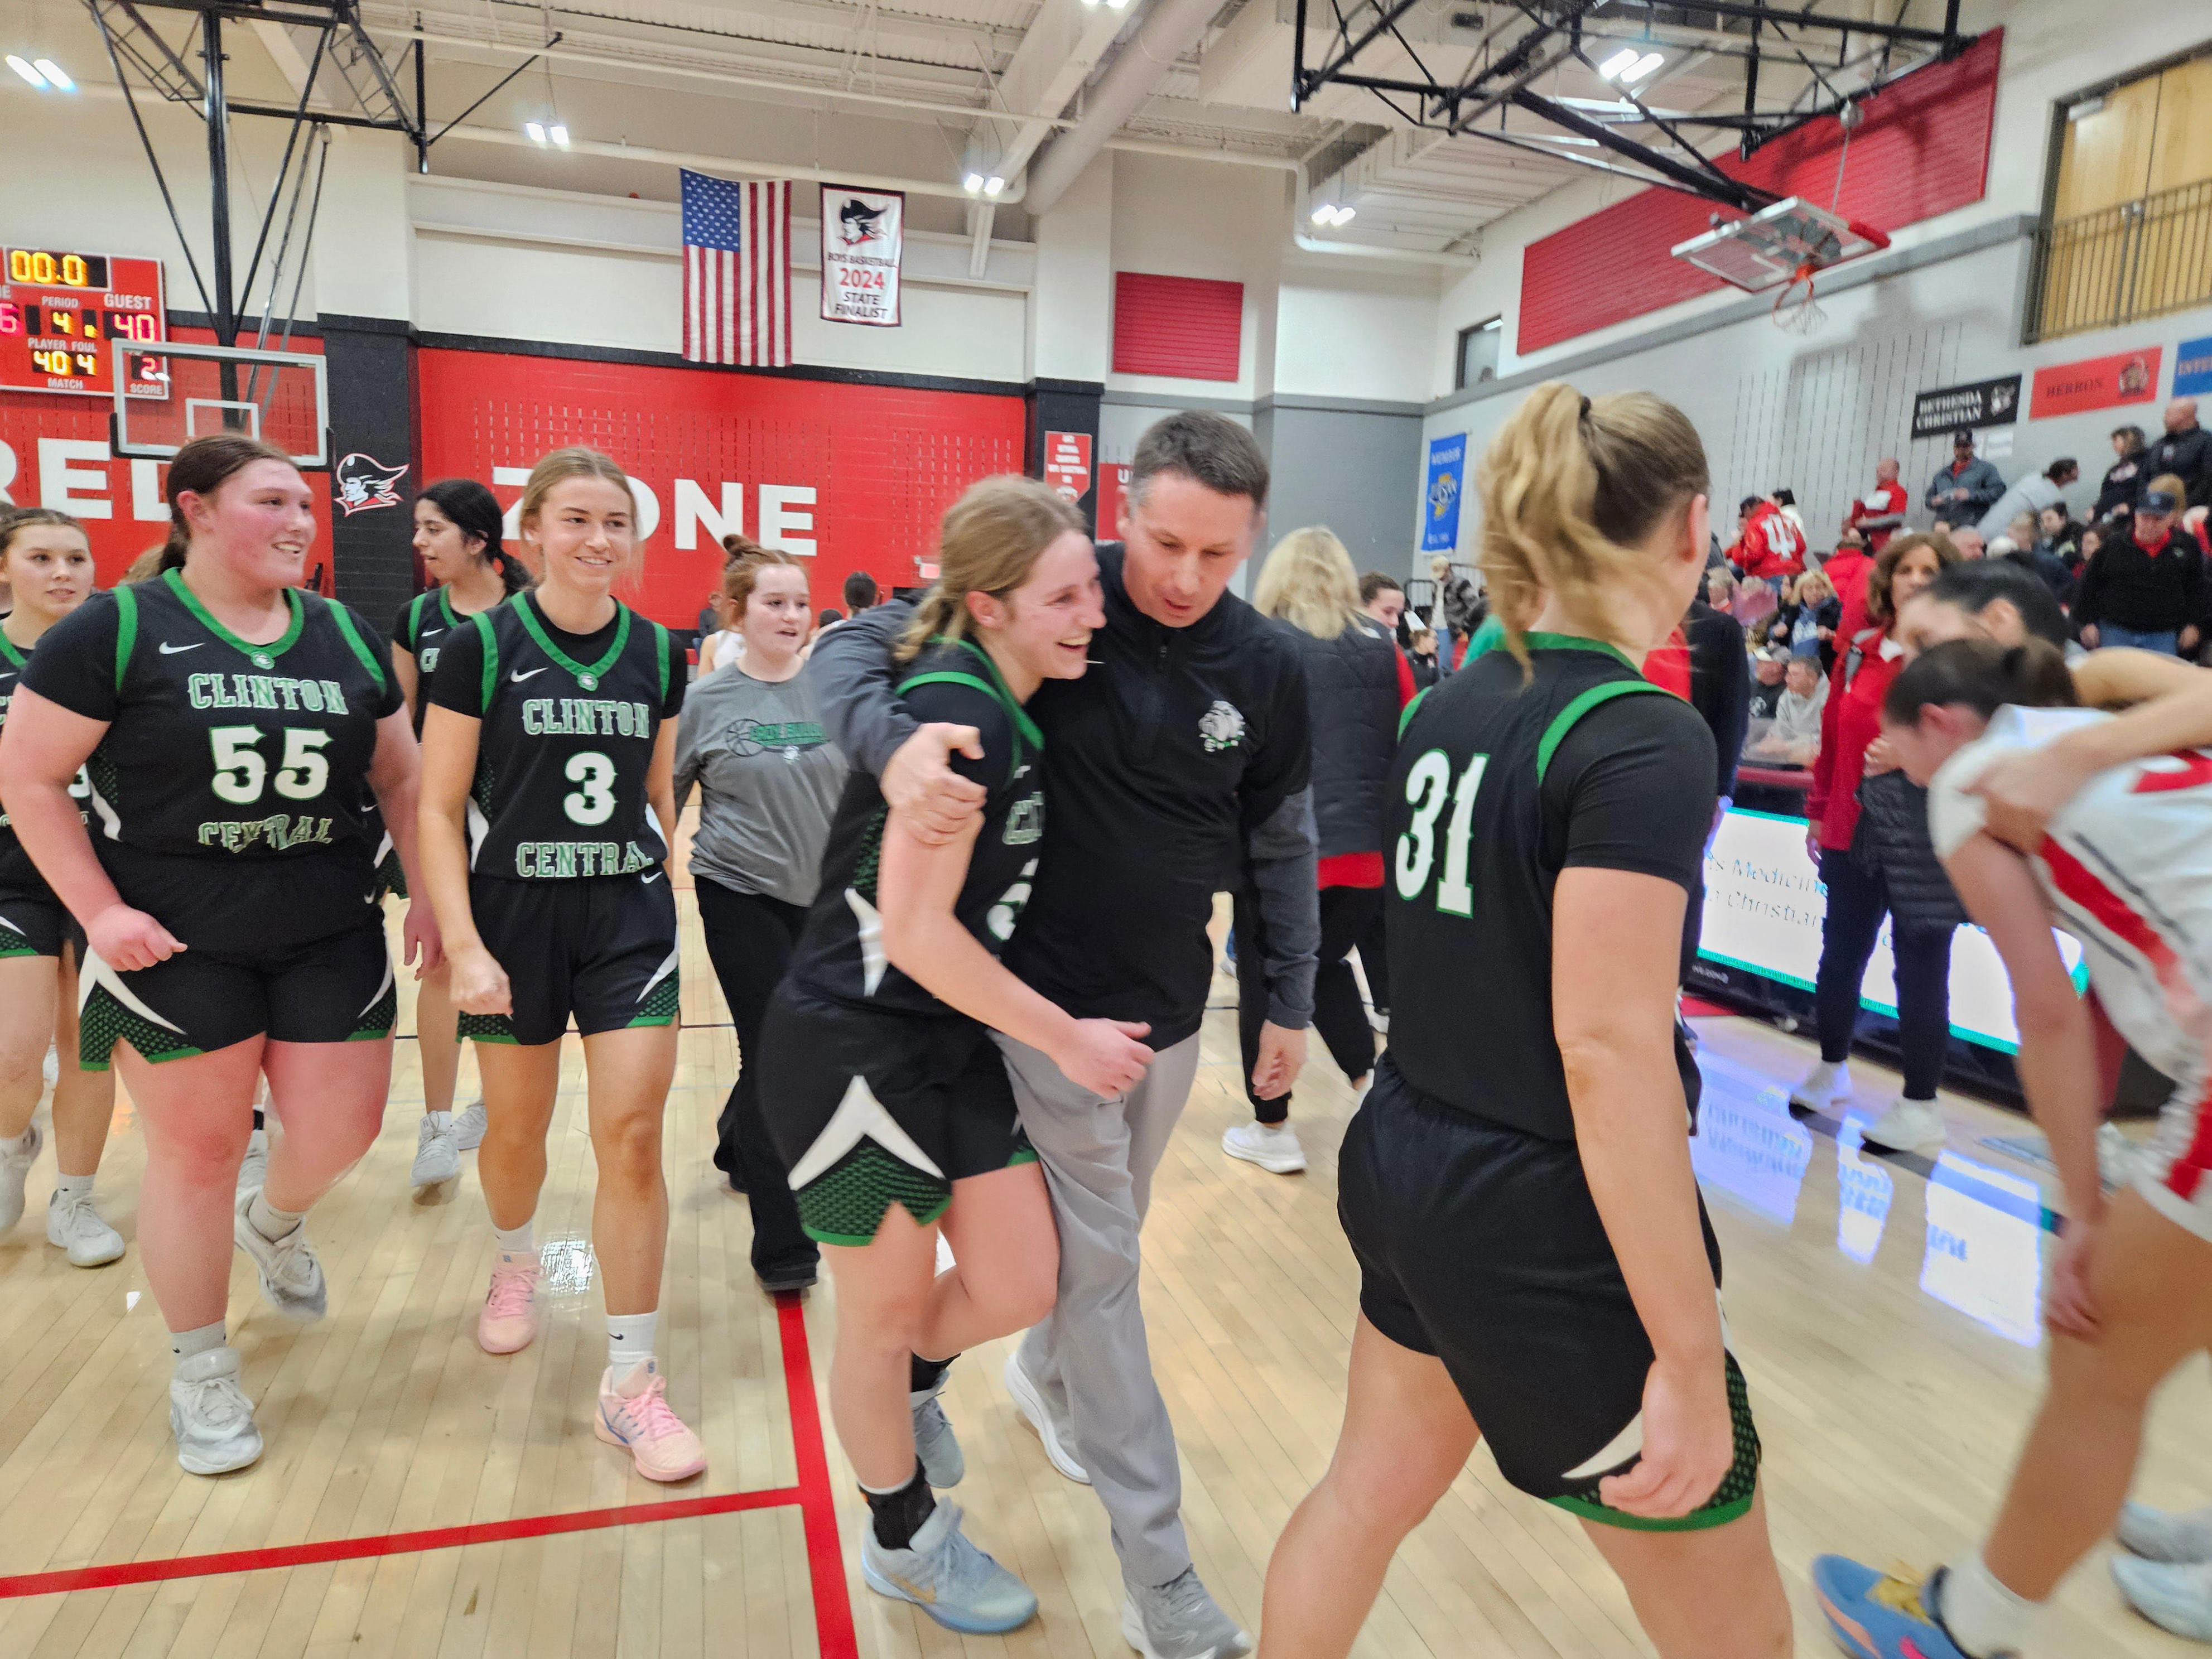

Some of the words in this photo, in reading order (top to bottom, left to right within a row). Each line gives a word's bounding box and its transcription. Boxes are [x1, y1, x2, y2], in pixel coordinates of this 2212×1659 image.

[840, 267, 885, 290] 2024
[42, 296, 80, 307] PERIOD
[104, 293, 152, 310] GUEST
[844, 292, 881, 305] STATE
[835, 303, 888, 319] FINALIST
[114, 314, 156, 343] 40
[28, 337, 66, 350] PLAYER
[72, 341, 97, 352] FOUL
[33, 350, 69, 376] 40
[77, 354, 96, 375] 4
[47, 377, 84, 389] MATCH
[129, 383, 163, 395] SCORE
[187, 673, 349, 715] CLINTON
[522, 698, 650, 739] CLINTON
[209, 724, 334, 804] 55
[563, 751, 619, 826] 3
[1395, 748, 1490, 919] 31
[515, 841, 654, 878] CENTRAL
